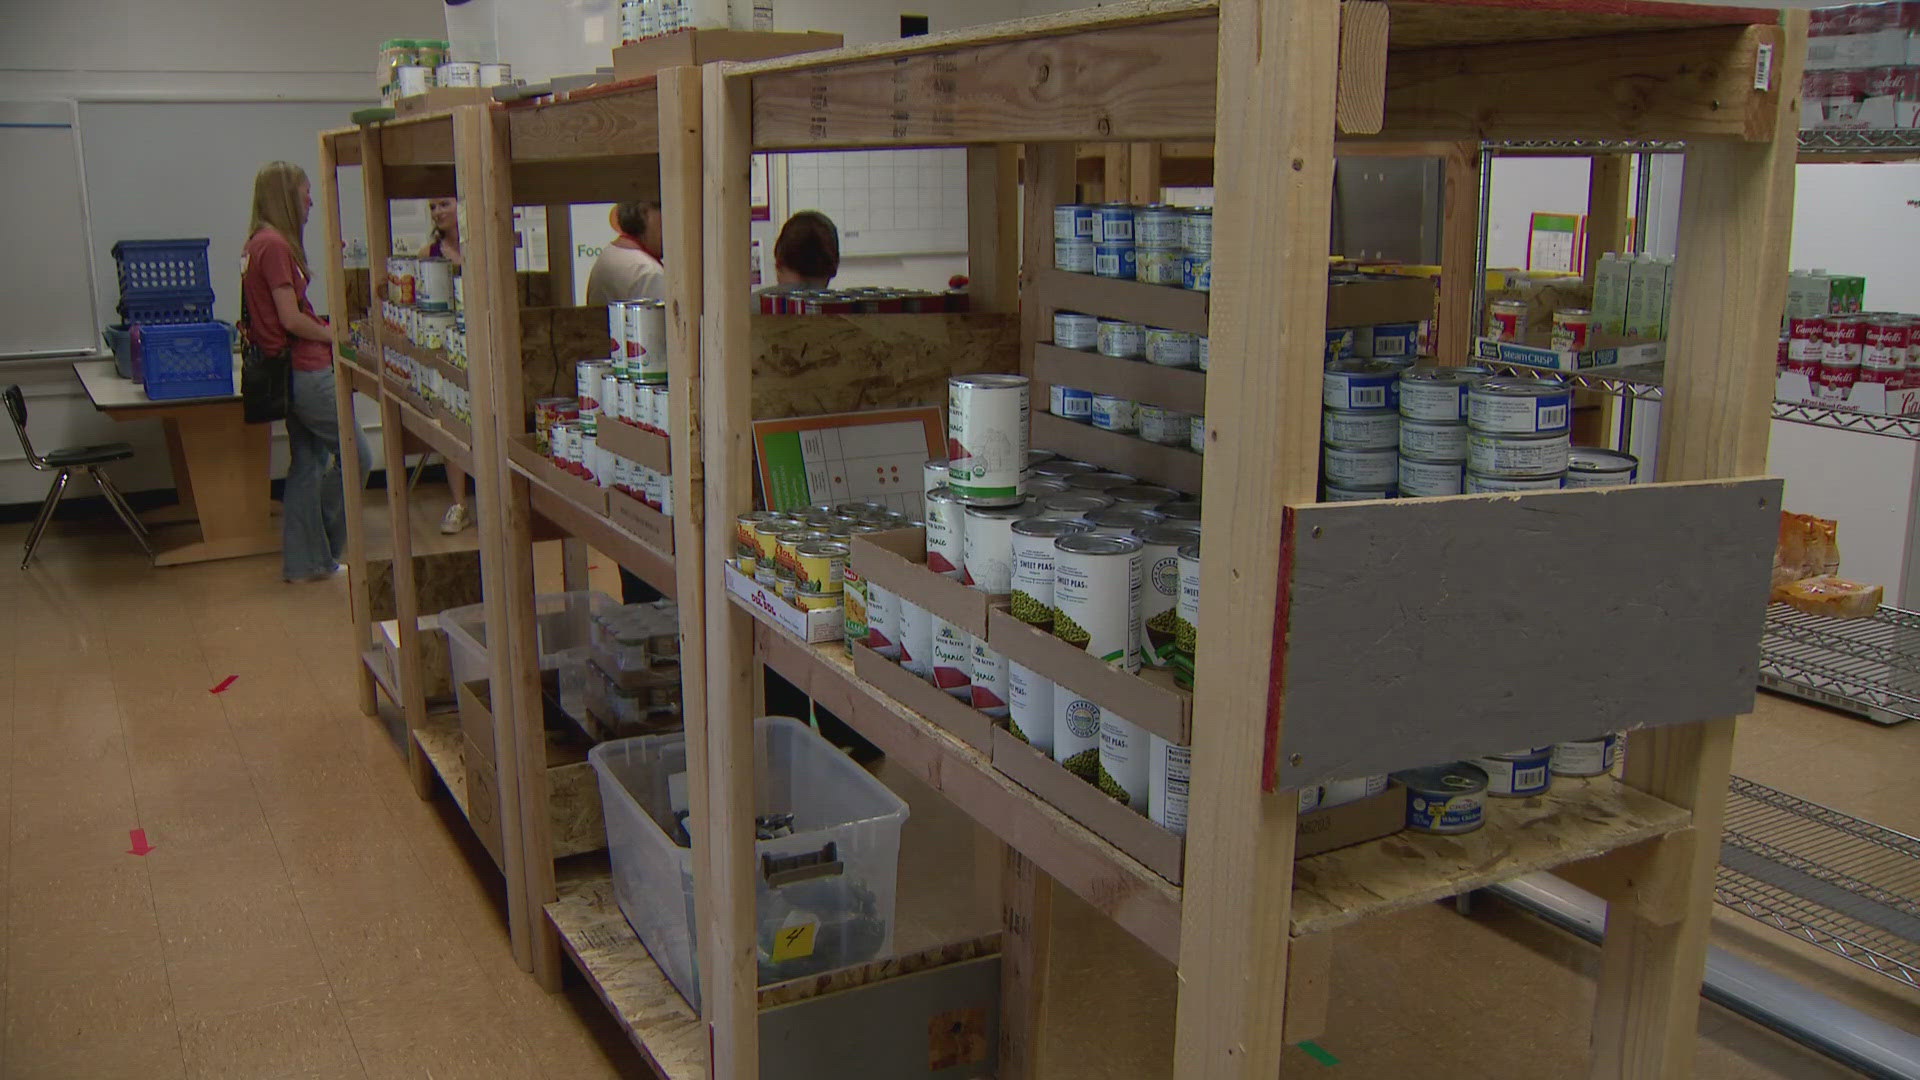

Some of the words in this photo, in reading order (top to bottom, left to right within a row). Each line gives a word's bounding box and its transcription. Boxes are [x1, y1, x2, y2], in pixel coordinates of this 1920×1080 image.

[1866, 329, 1901, 341] Campbell's
[1020, 560, 1036, 570] SWEET
[1037, 562, 1053, 571] PEAS
[1057, 575, 1070, 587] SWEET
[1070, 579, 1085, 589] PEAS
[1183, 586, 1199, 598] SWEET
[935, 645, 965, 663] Organic
[1111, 736, 1125, 748] PEAS
[785, 926, 805, 948] 4
